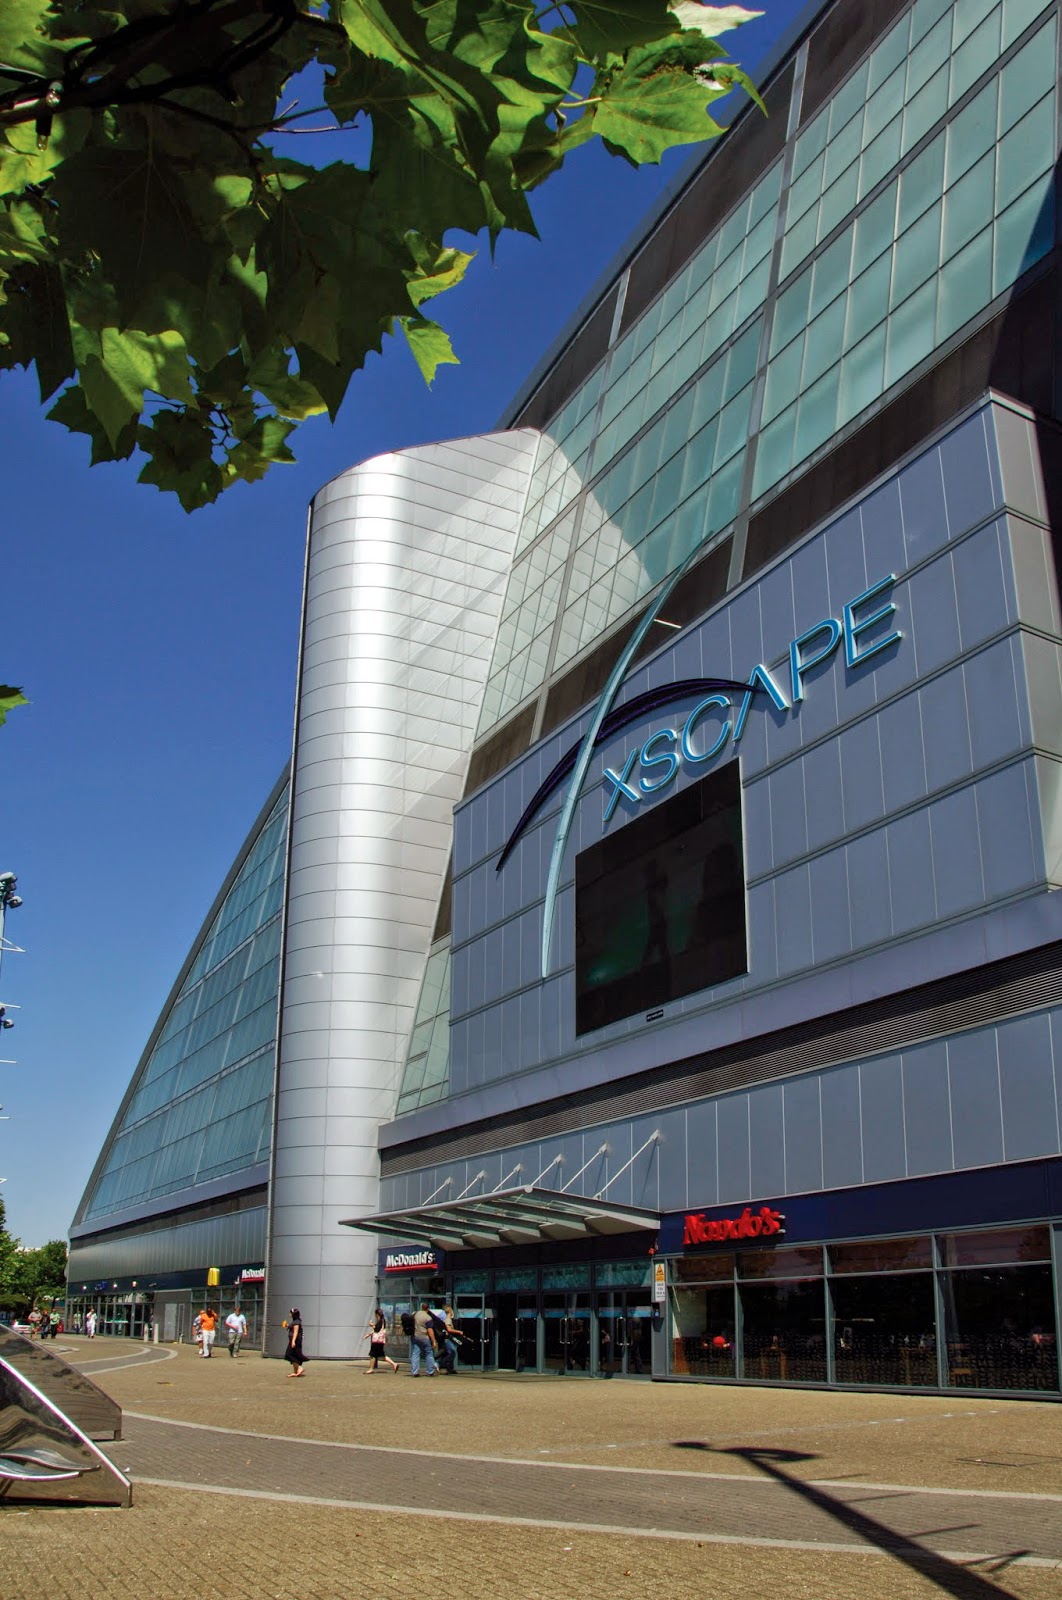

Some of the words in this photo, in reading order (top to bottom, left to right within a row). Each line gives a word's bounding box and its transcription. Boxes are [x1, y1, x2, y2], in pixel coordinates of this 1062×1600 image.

[602, 573, 902, 822] XSCAPE
[682, 1207, 780, 1245] Nando's
[386, 1251, 433, 1268] McDonald's
